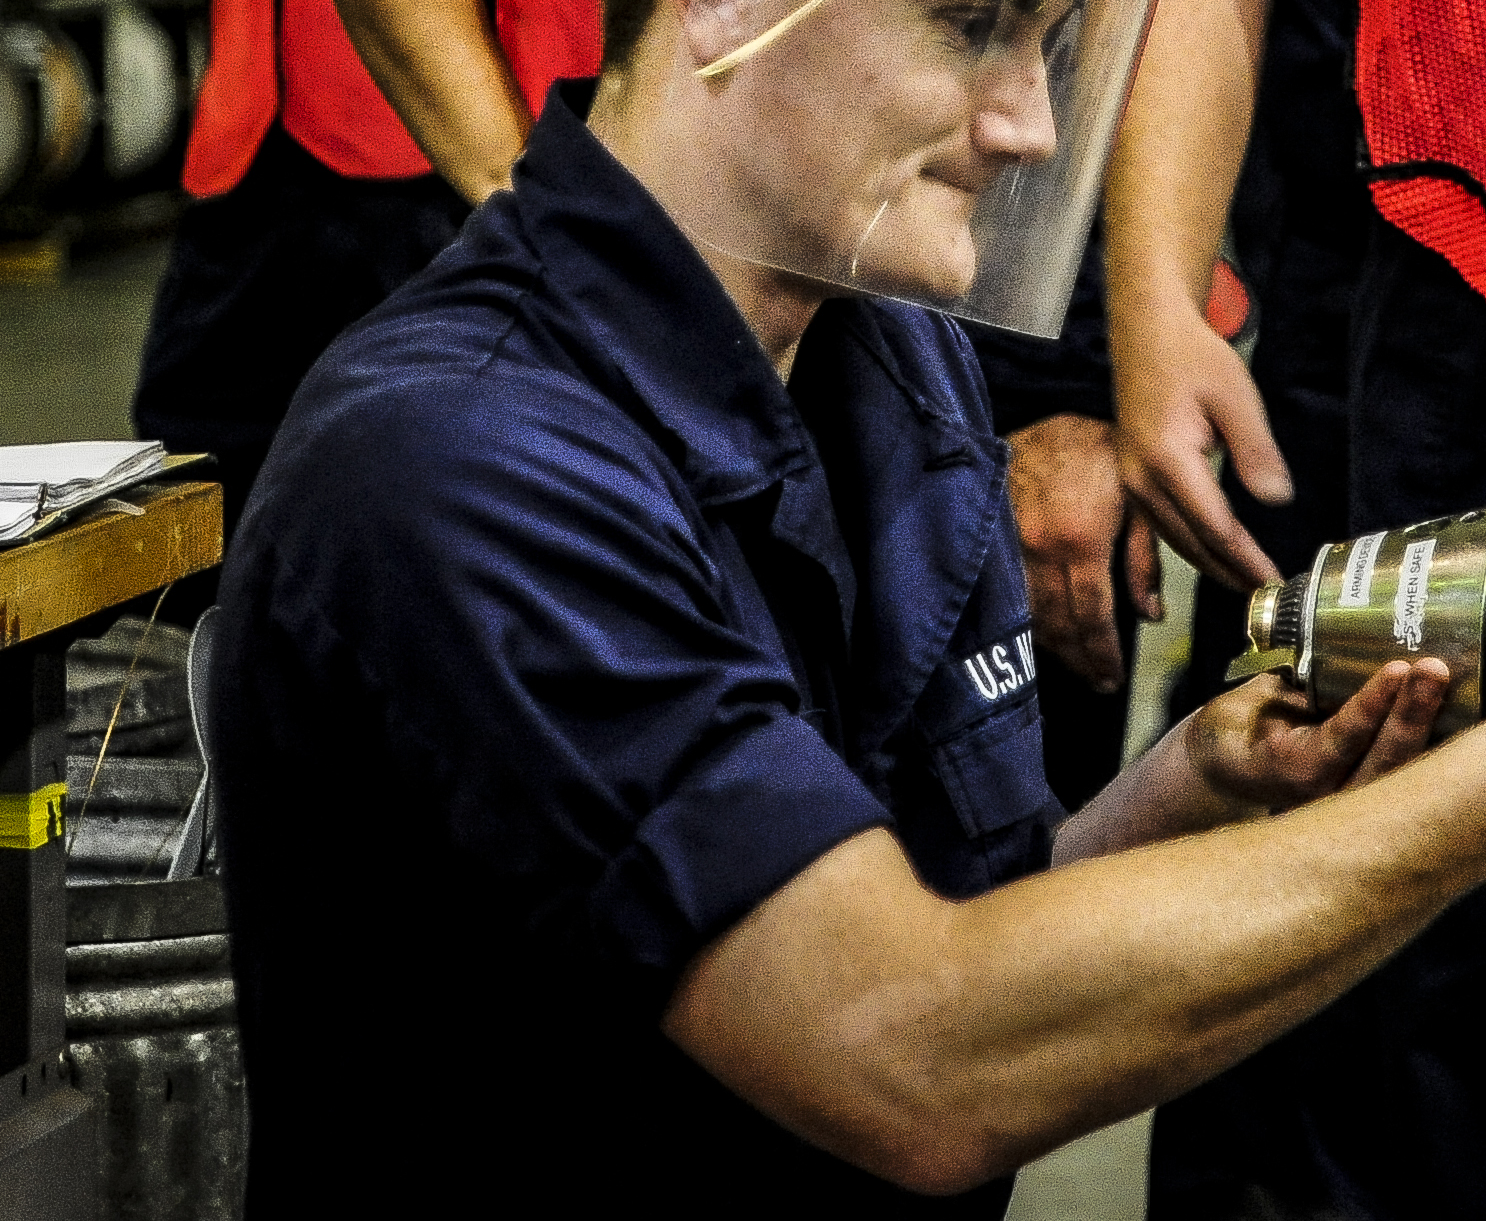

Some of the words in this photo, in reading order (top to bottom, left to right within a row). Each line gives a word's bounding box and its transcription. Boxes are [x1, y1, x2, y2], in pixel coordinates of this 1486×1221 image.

[1409, 545, 1426, 574] SAFE
[1404, 576, 1419, 617] WHEN
[964, 645, 1023, 699] U.S.
